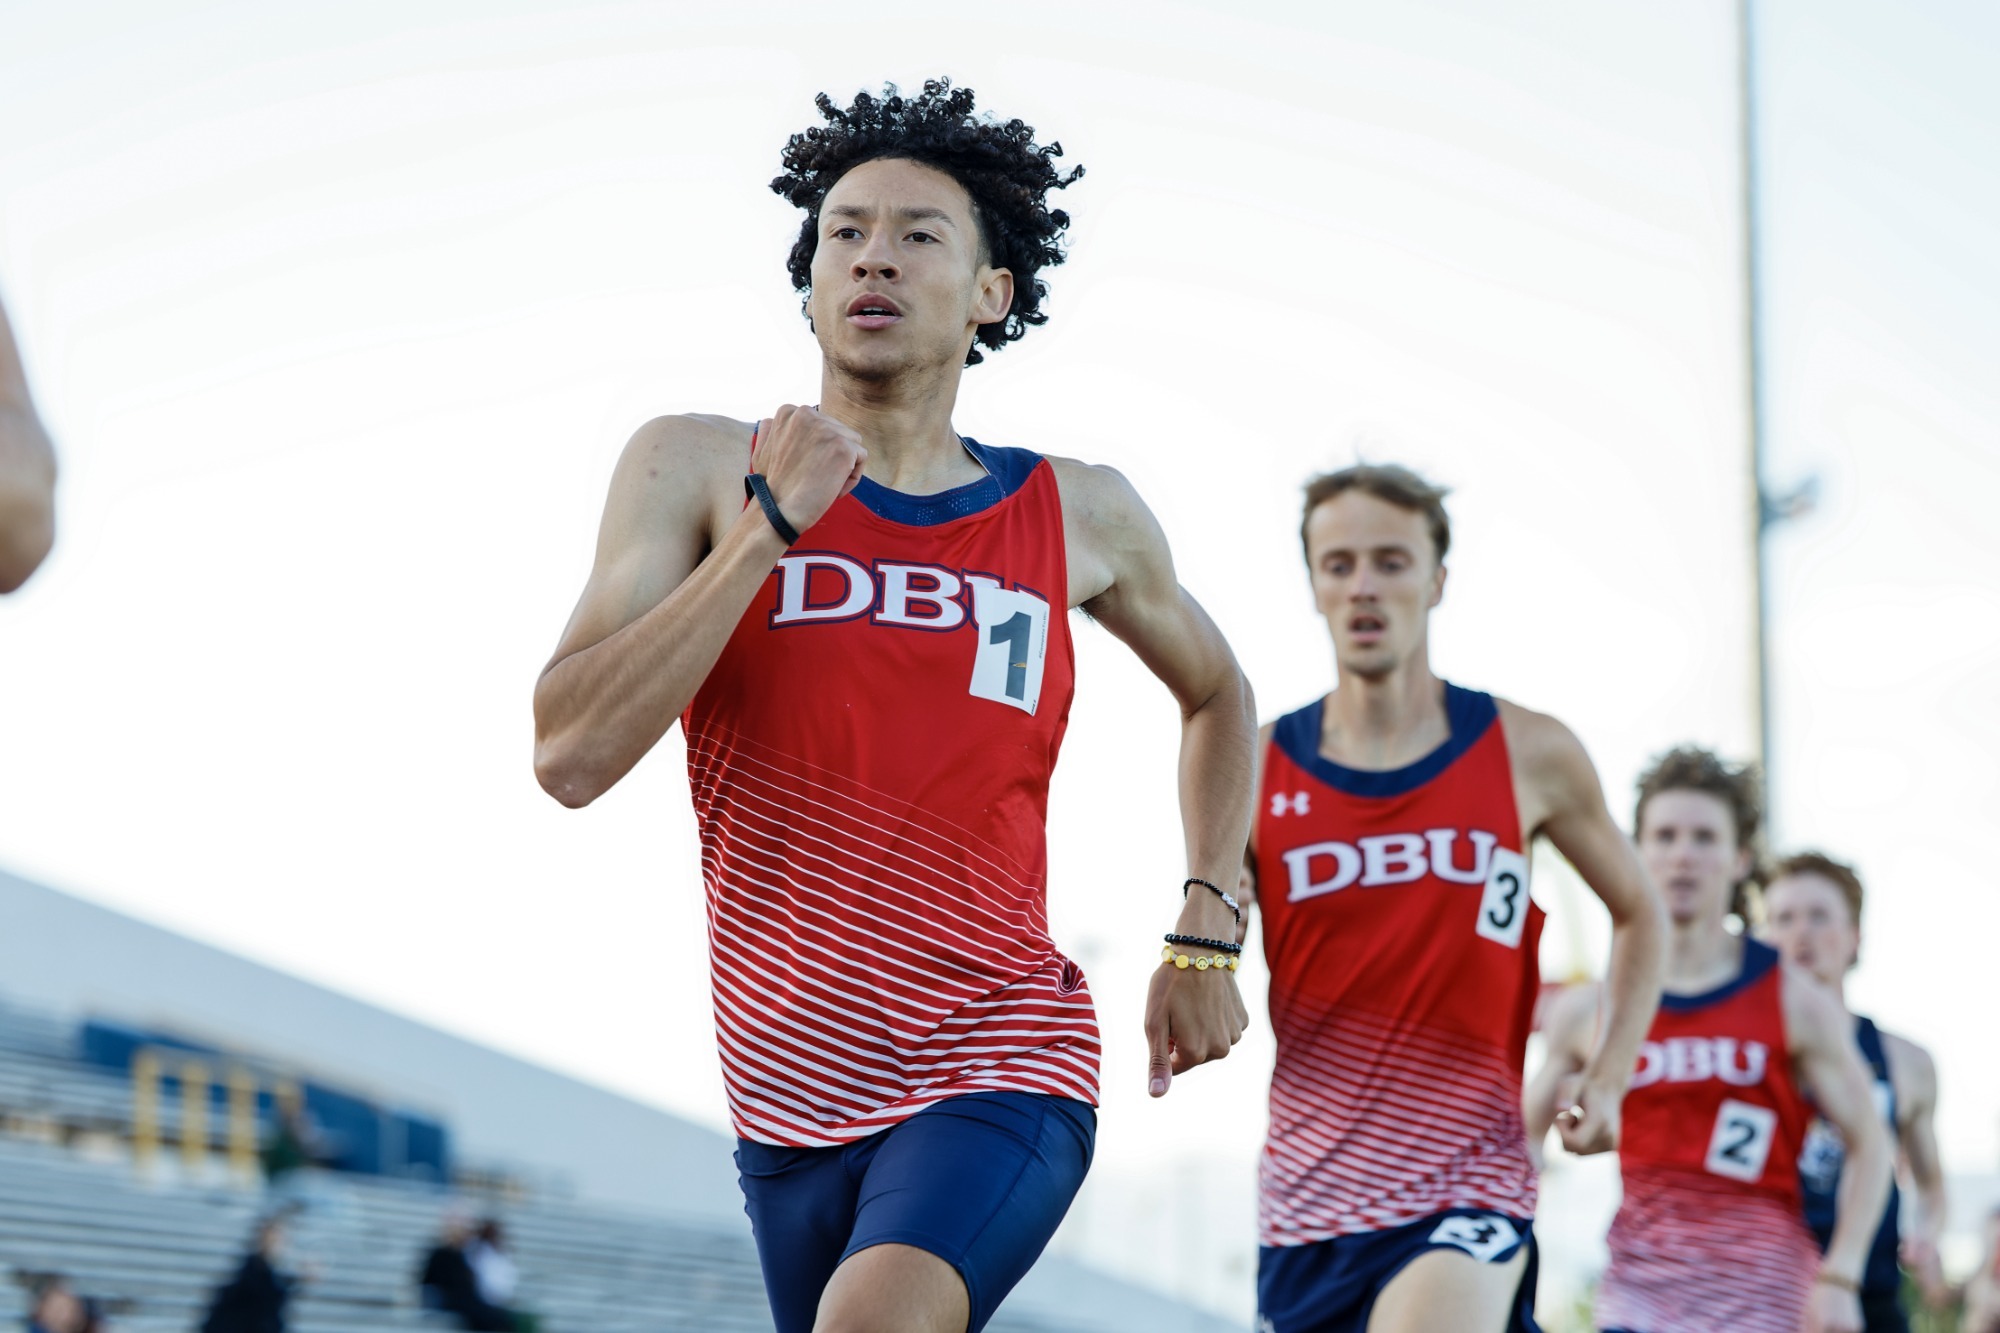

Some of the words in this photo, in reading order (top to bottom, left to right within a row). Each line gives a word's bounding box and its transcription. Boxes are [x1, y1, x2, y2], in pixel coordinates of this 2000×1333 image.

[989, 610, 1032, 702] 1
[1282, 828, 1498, 904] DBU
[1488, 871, 1520, 929] 3
[1720, 1118, 1757, 1166] 2
